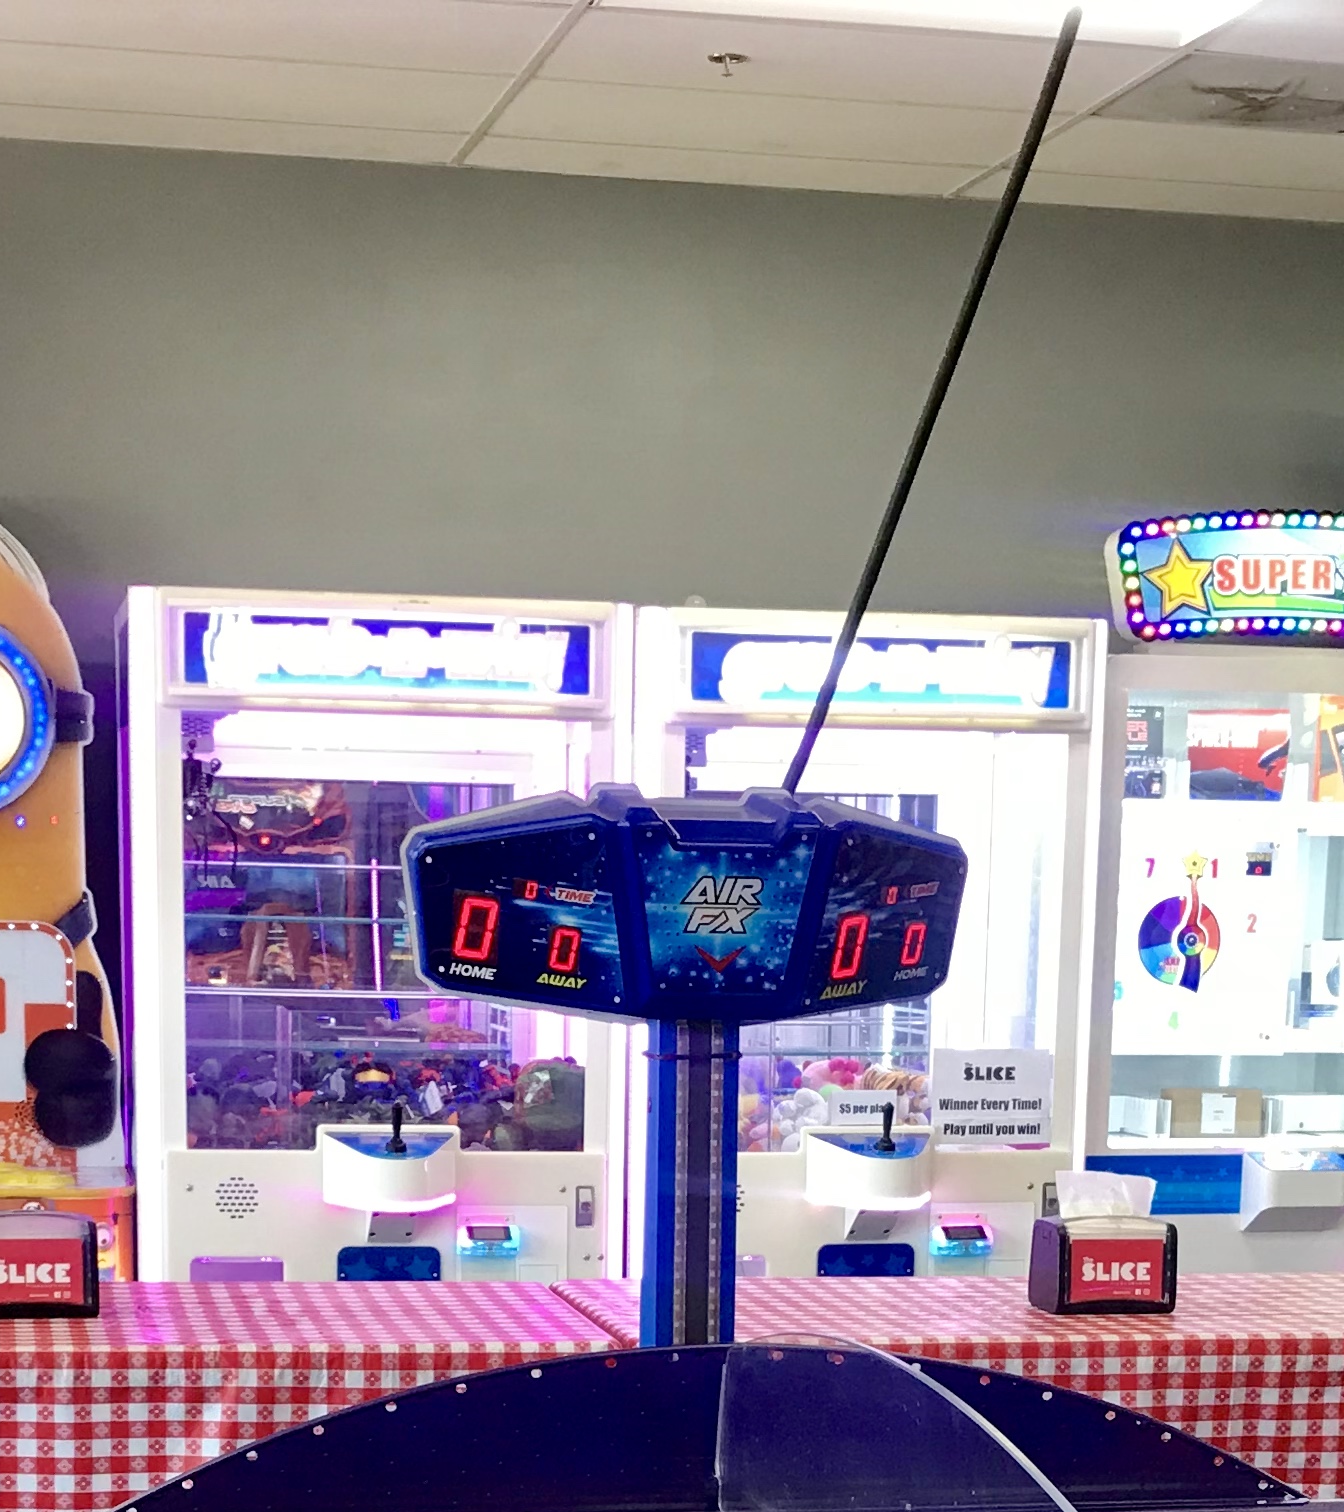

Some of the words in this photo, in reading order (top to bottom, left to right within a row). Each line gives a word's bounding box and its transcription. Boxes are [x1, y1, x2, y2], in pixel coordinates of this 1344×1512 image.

[1212, 553, 1336, 596] SUPER
[1145, 857, 1155, 878] 7
[1210, 858, 1219, 879] 1
[525, 880, 538, 899] 0
[557, 889, 594, 903] TIME
[680, 876, 764, 905] AIR
[454, 896, 499, 960] 0
[683, 906, 760, 934] FX
[1246, 913, 1258, 933] 2
[549, 928, 581, 971] 0
[831, 915, 869, 979] 0
[900, 923, 926, 965] 0
[449, 962, 497, 980] HOME
[536, 973, 587, 989] AWAY
[893, 966, 929, 981] HOME
[820, 979, 868, 1000] AWAY
[963, 1066, 1016, 1081] SLICE
[839, 1103, 852, 1114] $5
[853, 1105, 868, 1115] per
[869, 1103, 886, 1115] pla
[939, 1098, 979, 1111] Winner
[981, 1098, 1008, 1113] Every
[1012, 1098, 1042, 1111] Time!
[943, 1123, 967, 1136] Play
[969, 1123, 994, 1135] until
[995, 1126, 1015, 1136] you
[1017, 1123, 1041, 1135] win!
[1081, 1261, 1151, 1282] SLICE
